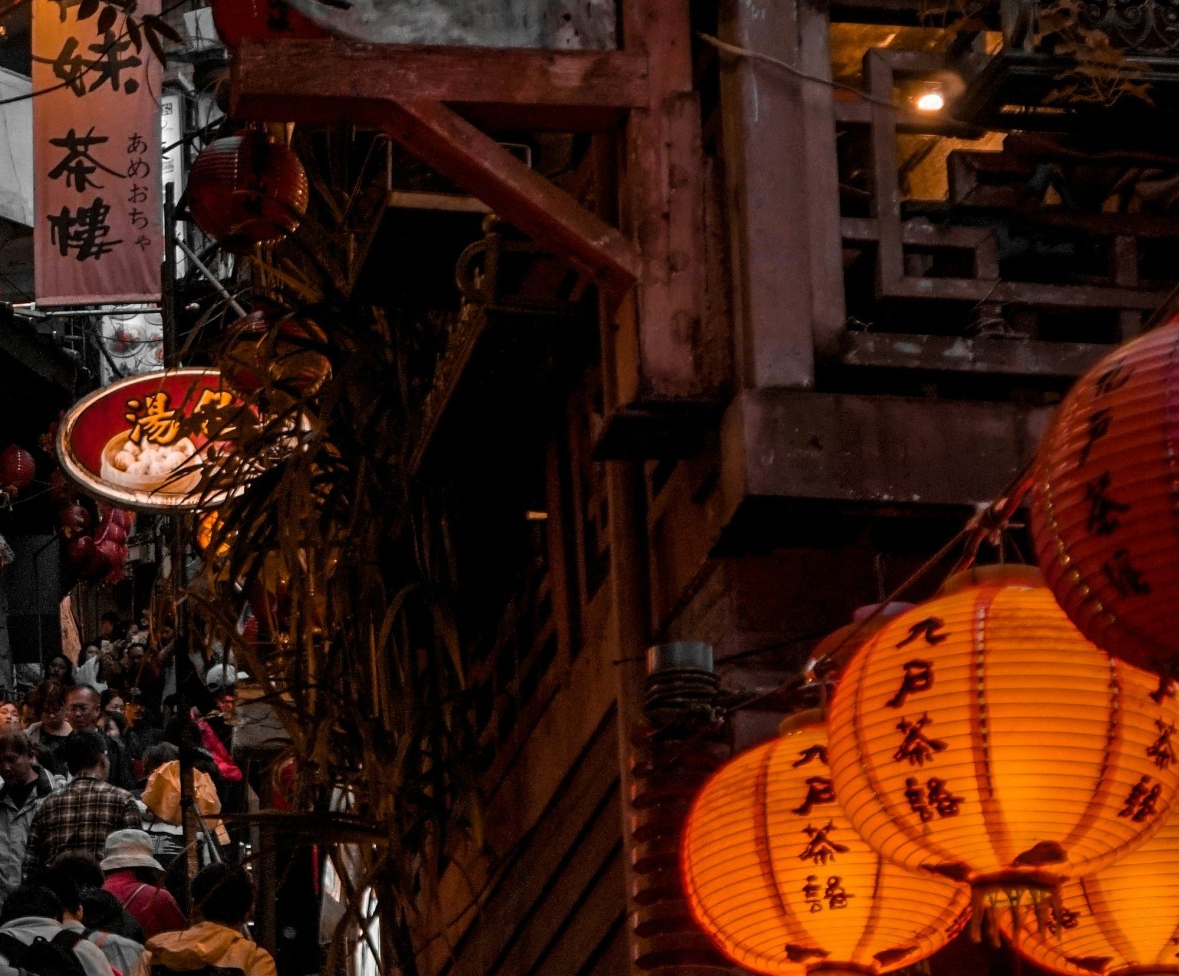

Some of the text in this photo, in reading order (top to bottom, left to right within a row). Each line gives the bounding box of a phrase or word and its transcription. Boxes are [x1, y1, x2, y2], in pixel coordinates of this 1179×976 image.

[127, 132, 151, 251] あめおちゃ
